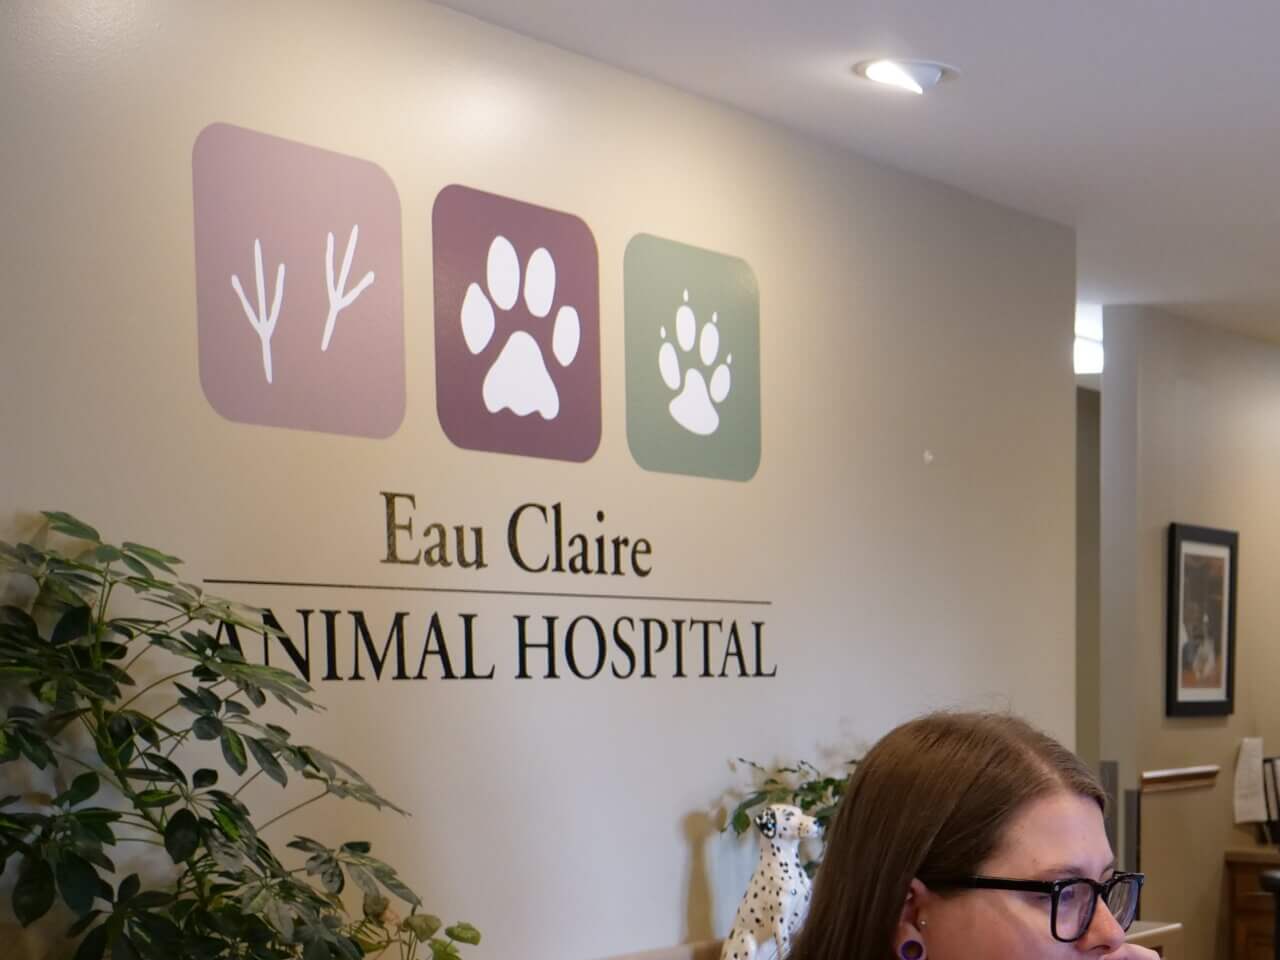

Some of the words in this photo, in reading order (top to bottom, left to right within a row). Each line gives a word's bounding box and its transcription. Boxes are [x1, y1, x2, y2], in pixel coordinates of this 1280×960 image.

[379, 491, 488, 569] Eau
[507, 502, 653, 577] Claire
[513, 614, 778, 681] HOSPITAL
